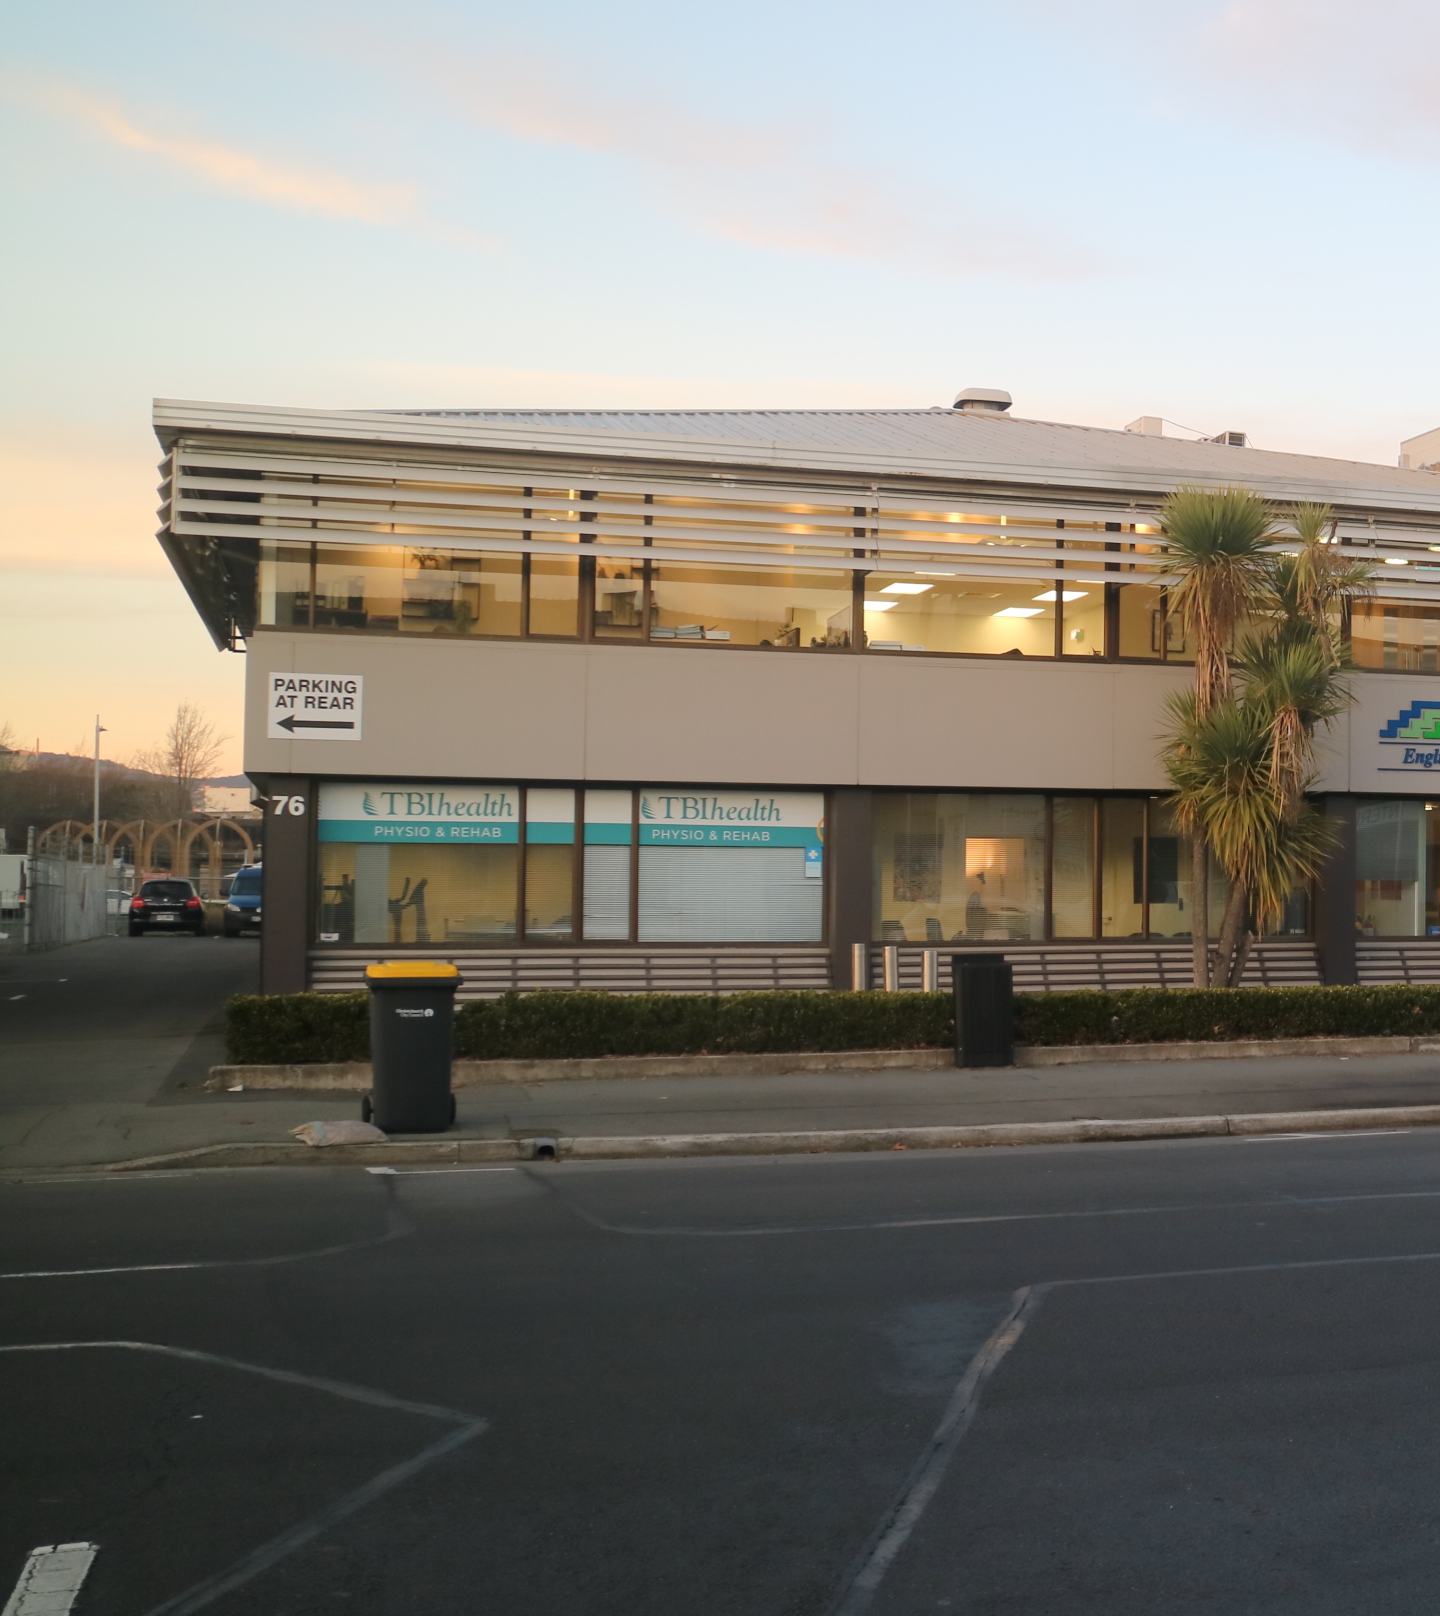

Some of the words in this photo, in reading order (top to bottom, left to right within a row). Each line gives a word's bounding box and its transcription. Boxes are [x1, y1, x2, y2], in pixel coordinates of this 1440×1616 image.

[274, 678, 357, 694] PARKING
[275, 695, 298, 709] AT
[304, 695, 354, 710] REAR
[272, 795, 305, 816] 76
[380, 791, 514, 818] TBIhealth
[658, 796, 782, 822] TBIhealth
[374, 826, 430, 837] PHYSIO
[435, 826, 445, 837] &
[450, 827, 501, 838] REHAB
[652, 829, 704, 840] PHYSIO
[709, 830, 718, 841] &
[723, 831, 771, 842] REHAB
